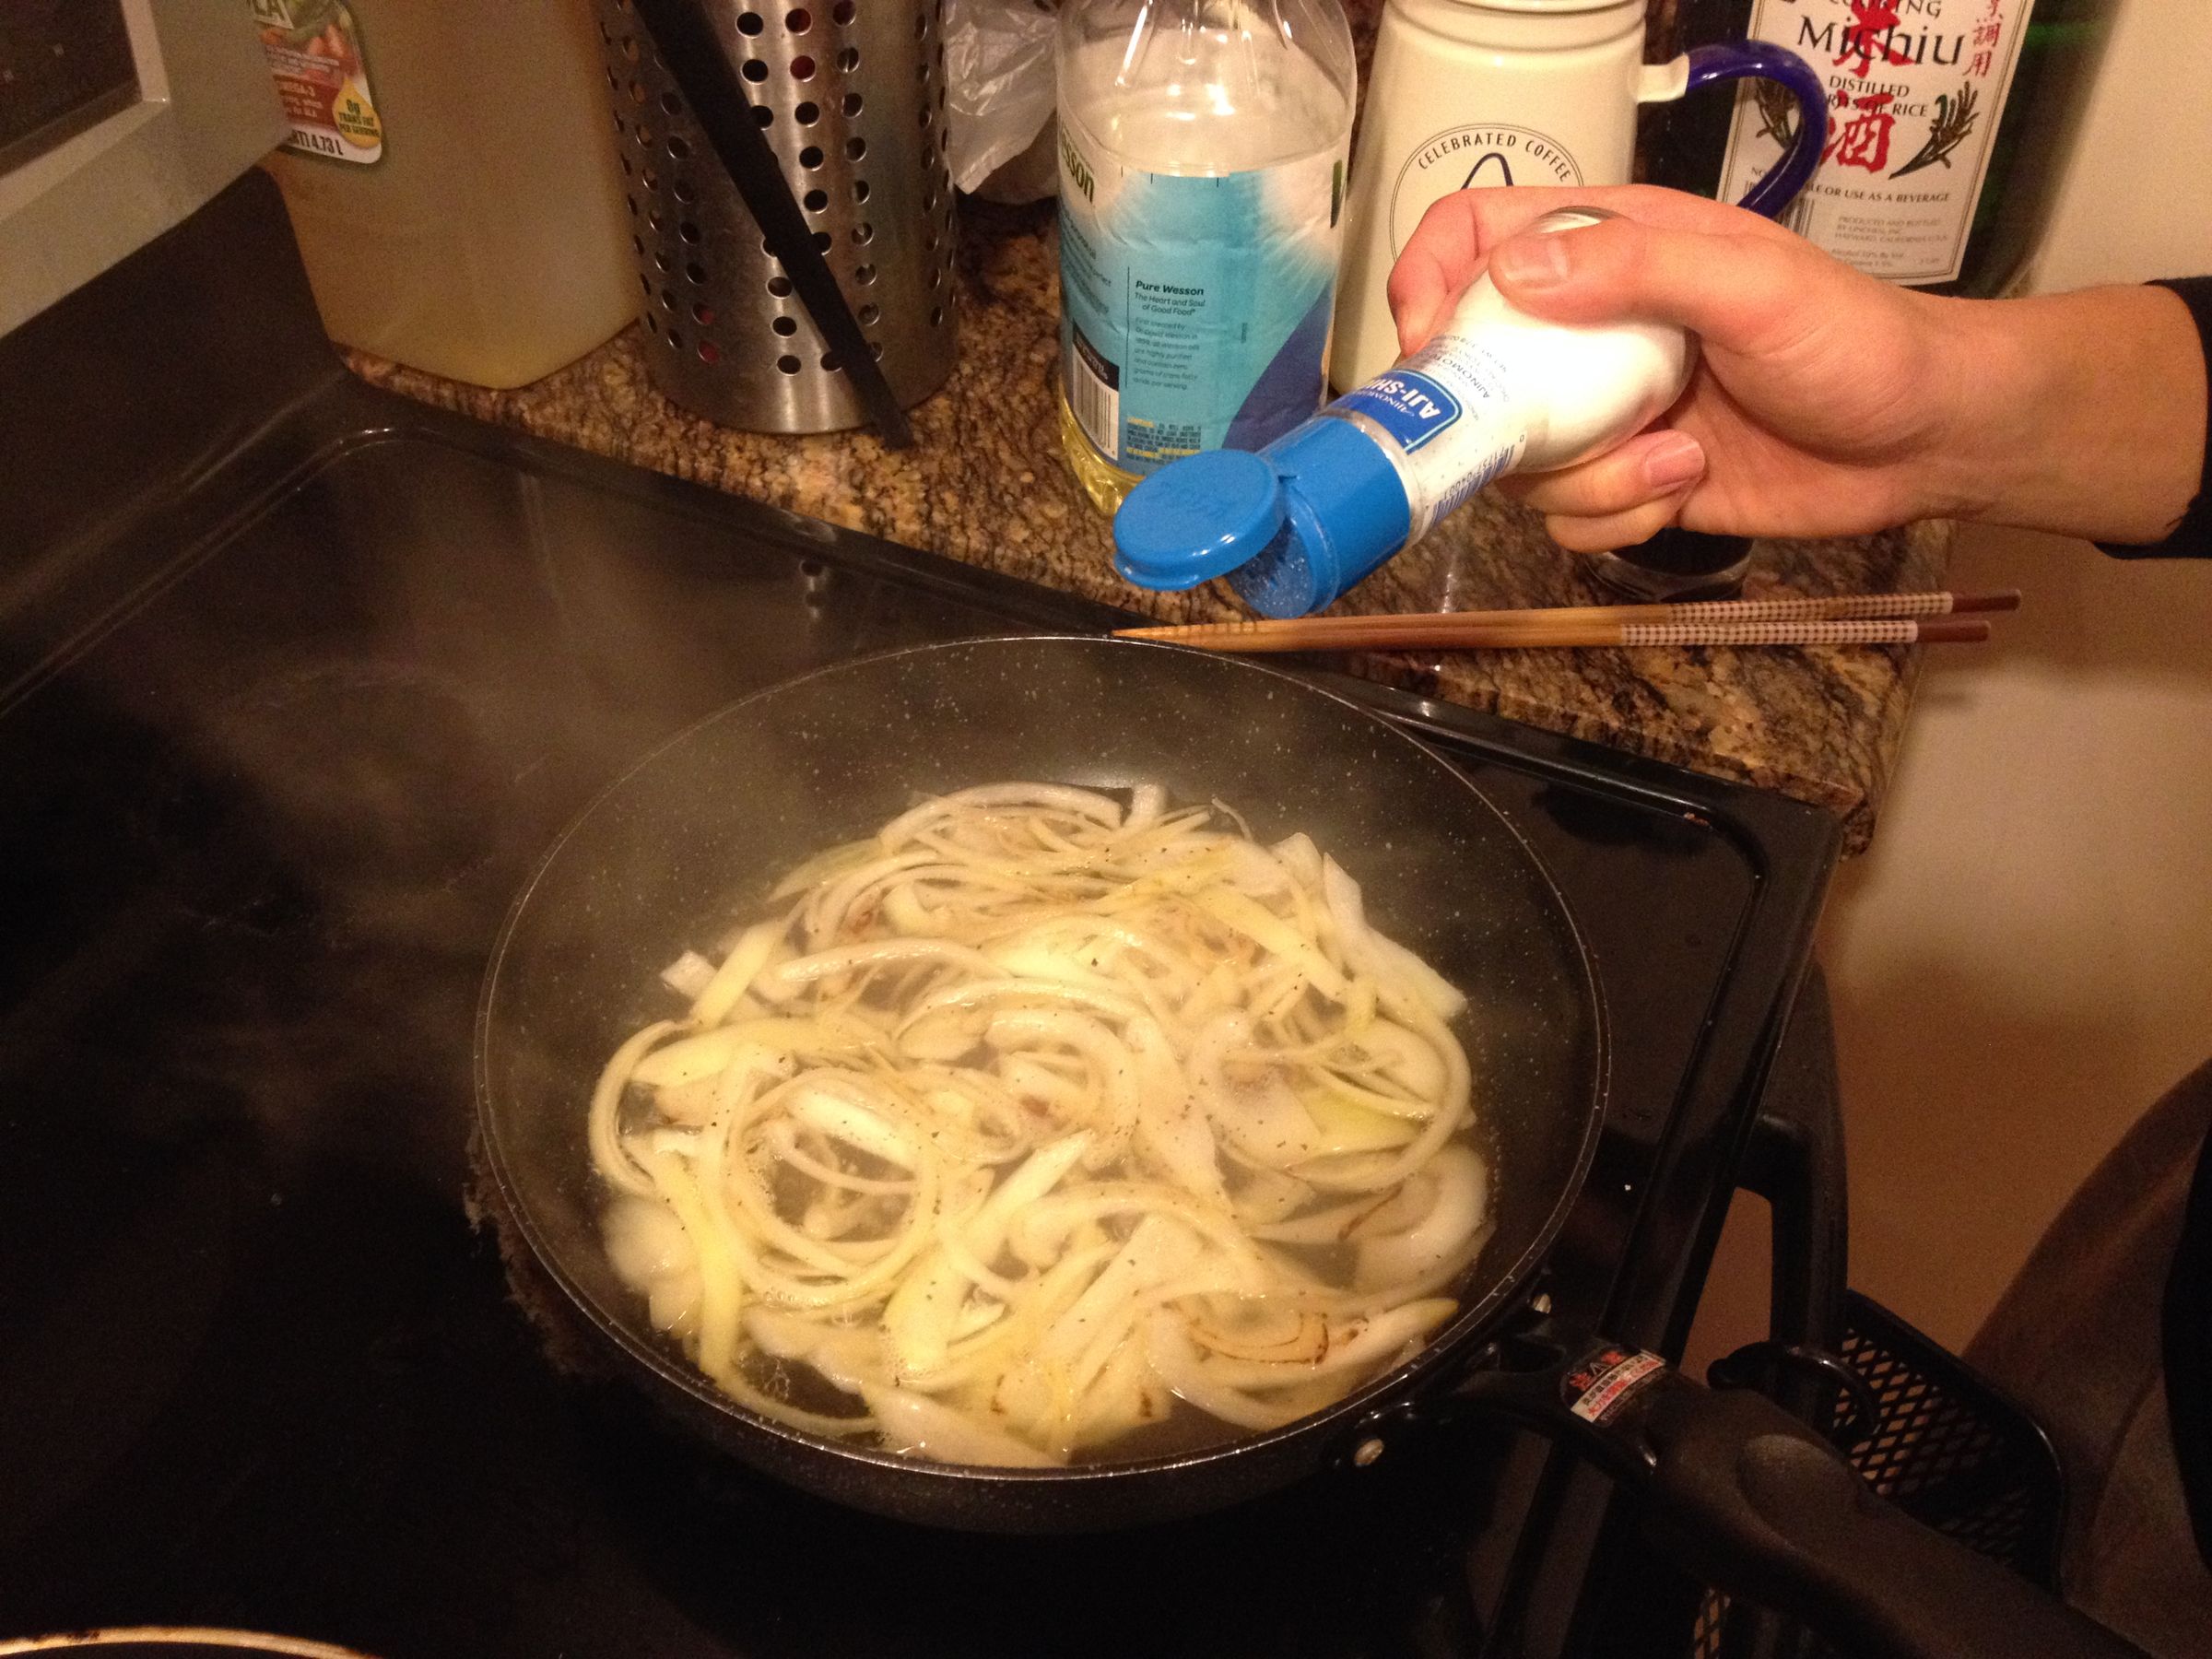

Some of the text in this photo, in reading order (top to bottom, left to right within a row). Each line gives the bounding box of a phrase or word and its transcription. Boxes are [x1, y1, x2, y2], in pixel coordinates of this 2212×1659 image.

[1798, 15, 1965, 65] Michiu
[1829, 75, 1910, 98] DISTILLED
[1892, 103, 1928, 118] RICE
[311, 133, 334, 154] 4.73
[1418, 133, 1571, 182] CELEBRATED COFFEE
[1824, 185, 1842, 197] OR
[1844, 189, 1865, 200] USE
[1867, 191, 1882, 201] AS
[1883, 192, 1893, 202] A
[1895, 193, 1950, 204] BEVERAGE
[1135, 280, 1205, 296] Pure Wesson
[1135, 292, 1206, 308] The Heart and Soul
[1150, 305, 1172, 314] Good
